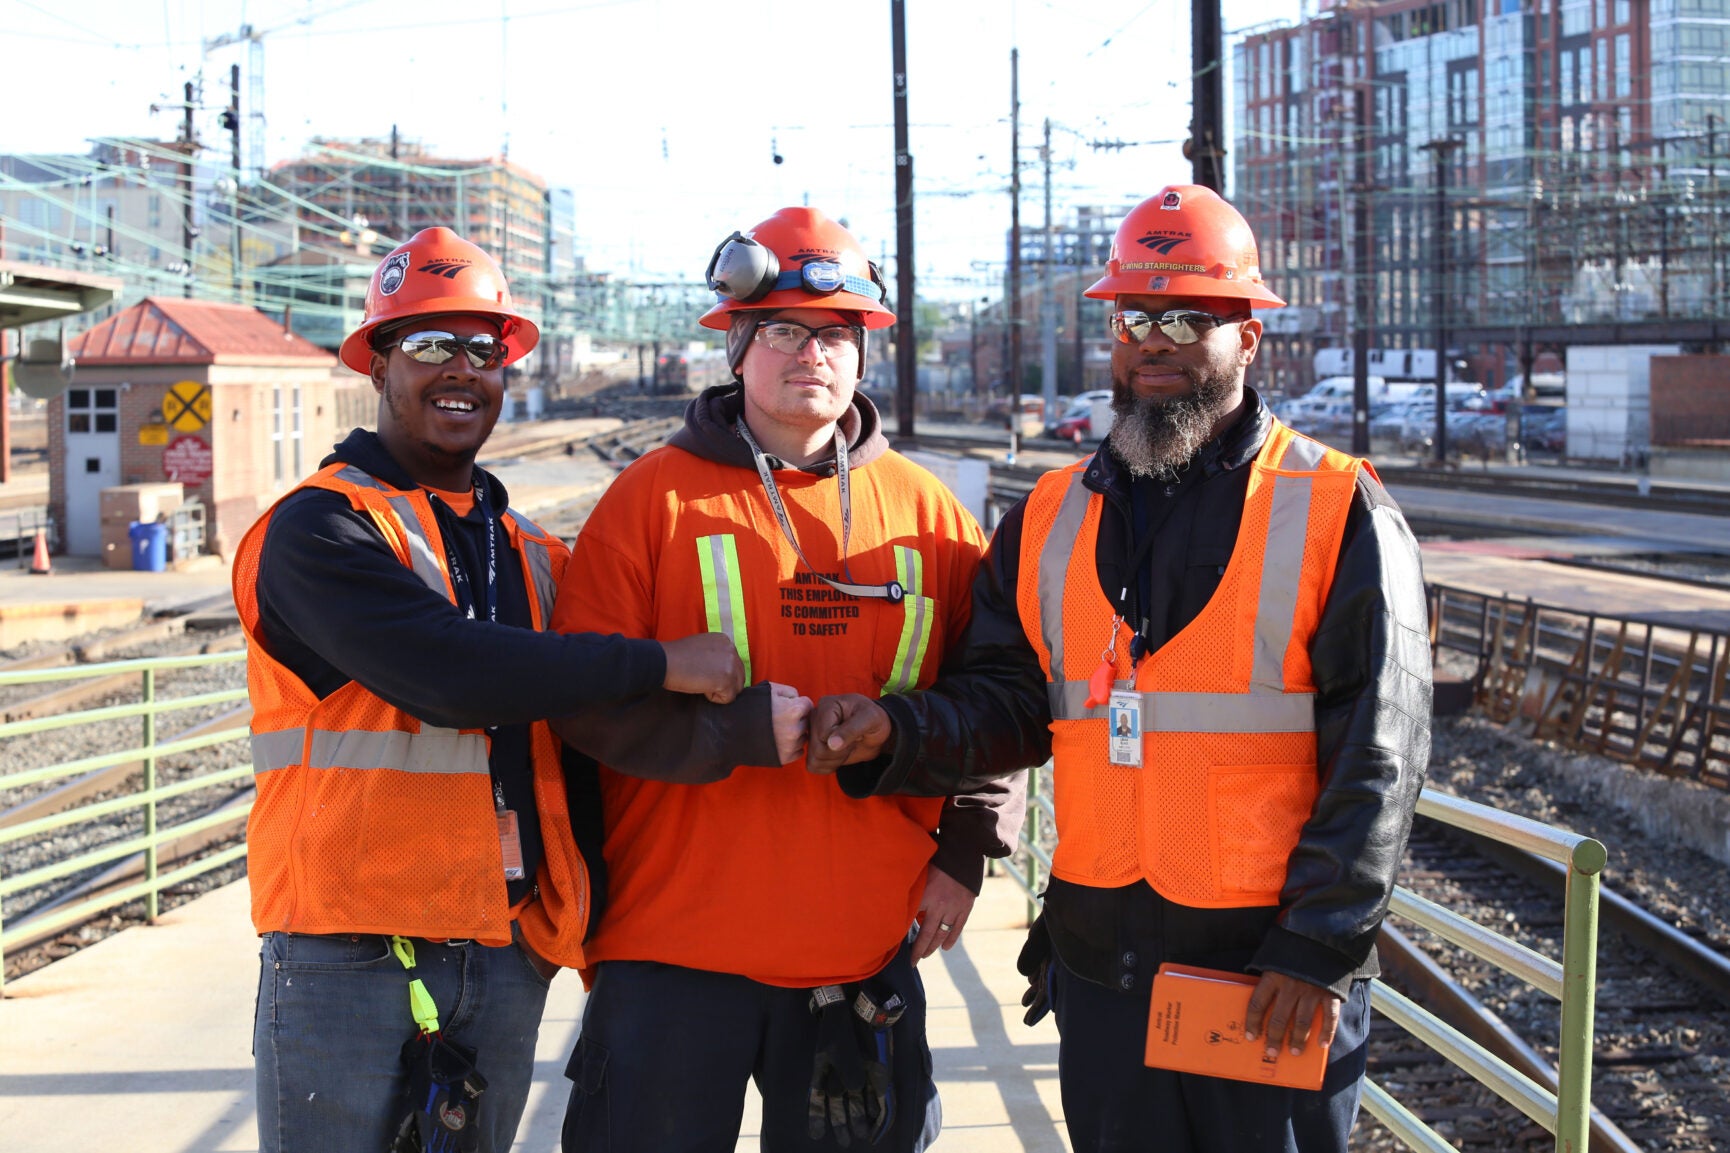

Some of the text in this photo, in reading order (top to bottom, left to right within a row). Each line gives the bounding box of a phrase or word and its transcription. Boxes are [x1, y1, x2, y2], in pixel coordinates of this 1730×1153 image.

[1144, 262, 1206, 272] STARFIGHTERS
[763, 471, 782, 511] AMTRAK
[780, 588, 804, 601] THIS
[781, 604, 859, 618] IS COMMITTED
[793, 623, 848, 635] TO SAFETY
[1209, 1031, 1221, 1043] W
